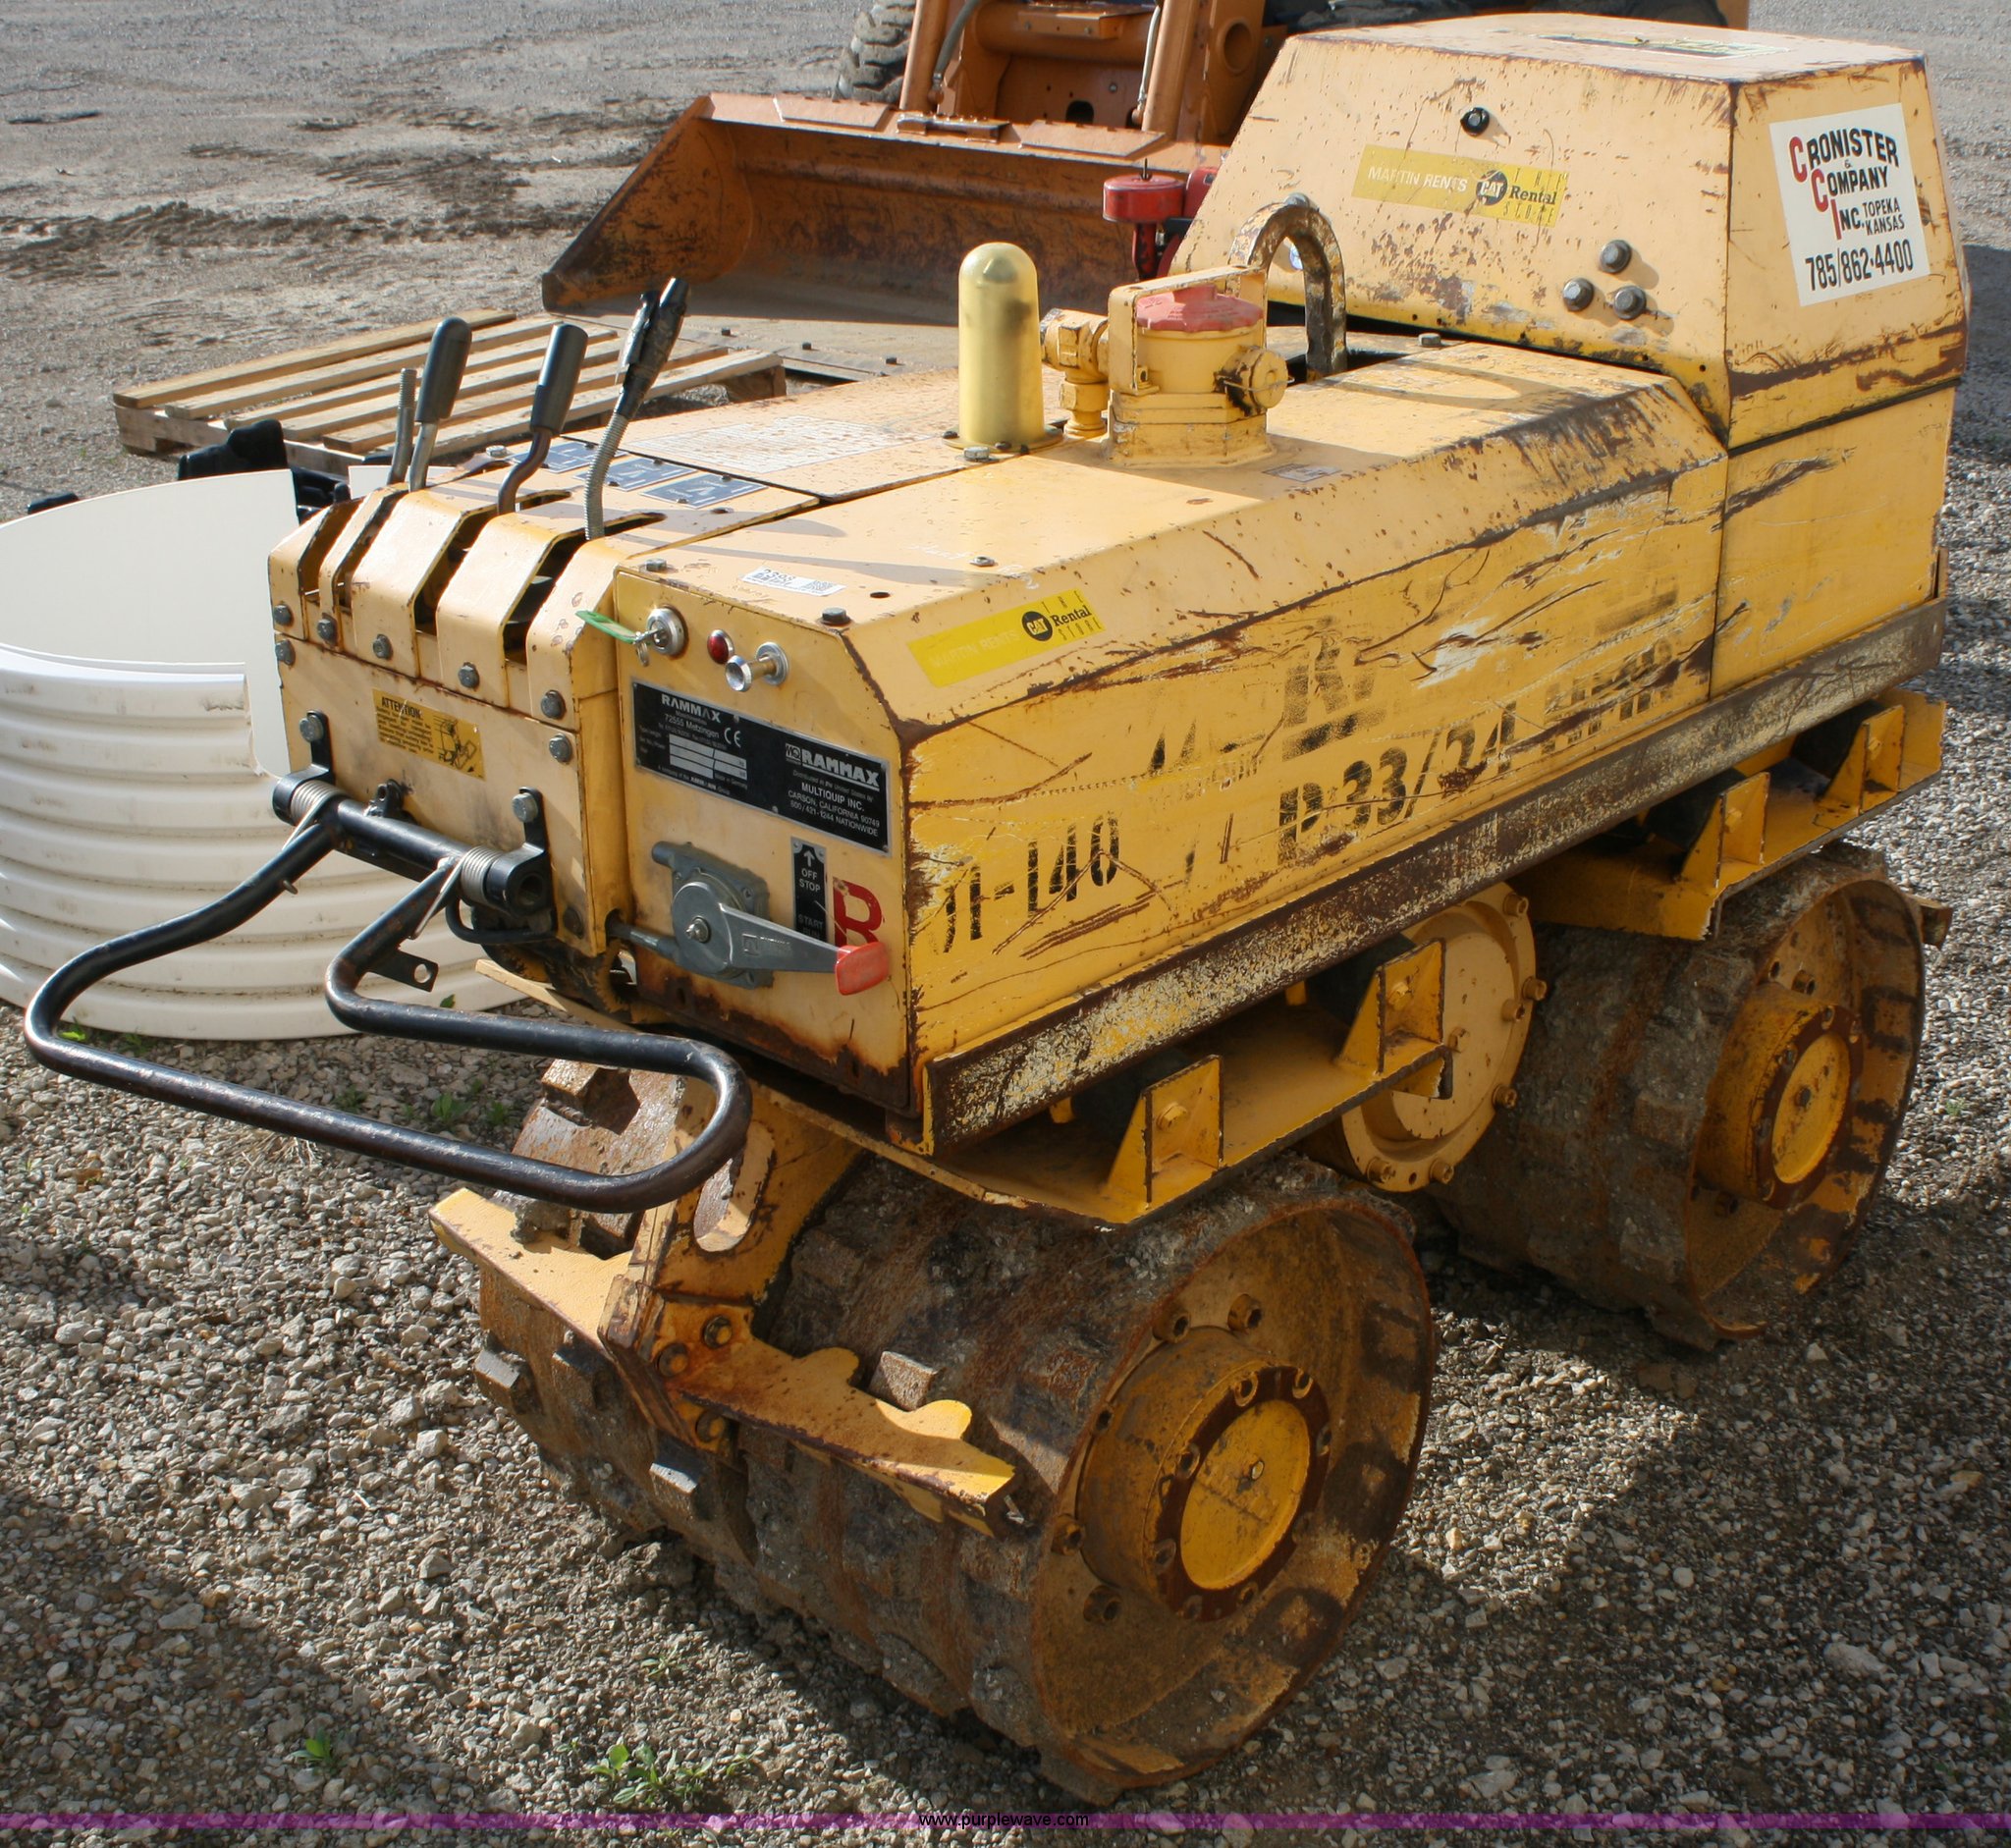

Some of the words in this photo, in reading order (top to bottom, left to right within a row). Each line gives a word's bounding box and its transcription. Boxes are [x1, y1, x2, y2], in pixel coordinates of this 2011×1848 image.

[1789, 128, 1900, 183] CRONISTER
[1844, 160, 1853, 169] &
[1367, 165, 1421, 186] MARTIN
[1479, 180, 1503, 197] CAT
[1508, 187, 1558, 205] Rental
[1811, 165, 1889, 212] COMPANY
[1830, 198, 1866, 241] INC.
[1863, 197, 1901, 218] TOPEKA
[1866, 214, 1905, 236] KANSAS
[1026, 618, 1049, 635] CAT
[1052, 605, 1092, 627] Rental
[661, 693, 722, 724] RAMMAX
[801, 748, 880, 788] RAMMAX
[801, 782, 845, 804] MULTIQUIP
[847, 798, 865, 812] INC.
[819, 800, 860, 821] CALIFORNIA
[836, 816, 879, 838] NATIONWIDE
[798, 878, 821, 893] STOP
[801, 869, 818, 881] OFF
[798, 913, 824, 929] START
[833, 877, 883, 949] R
